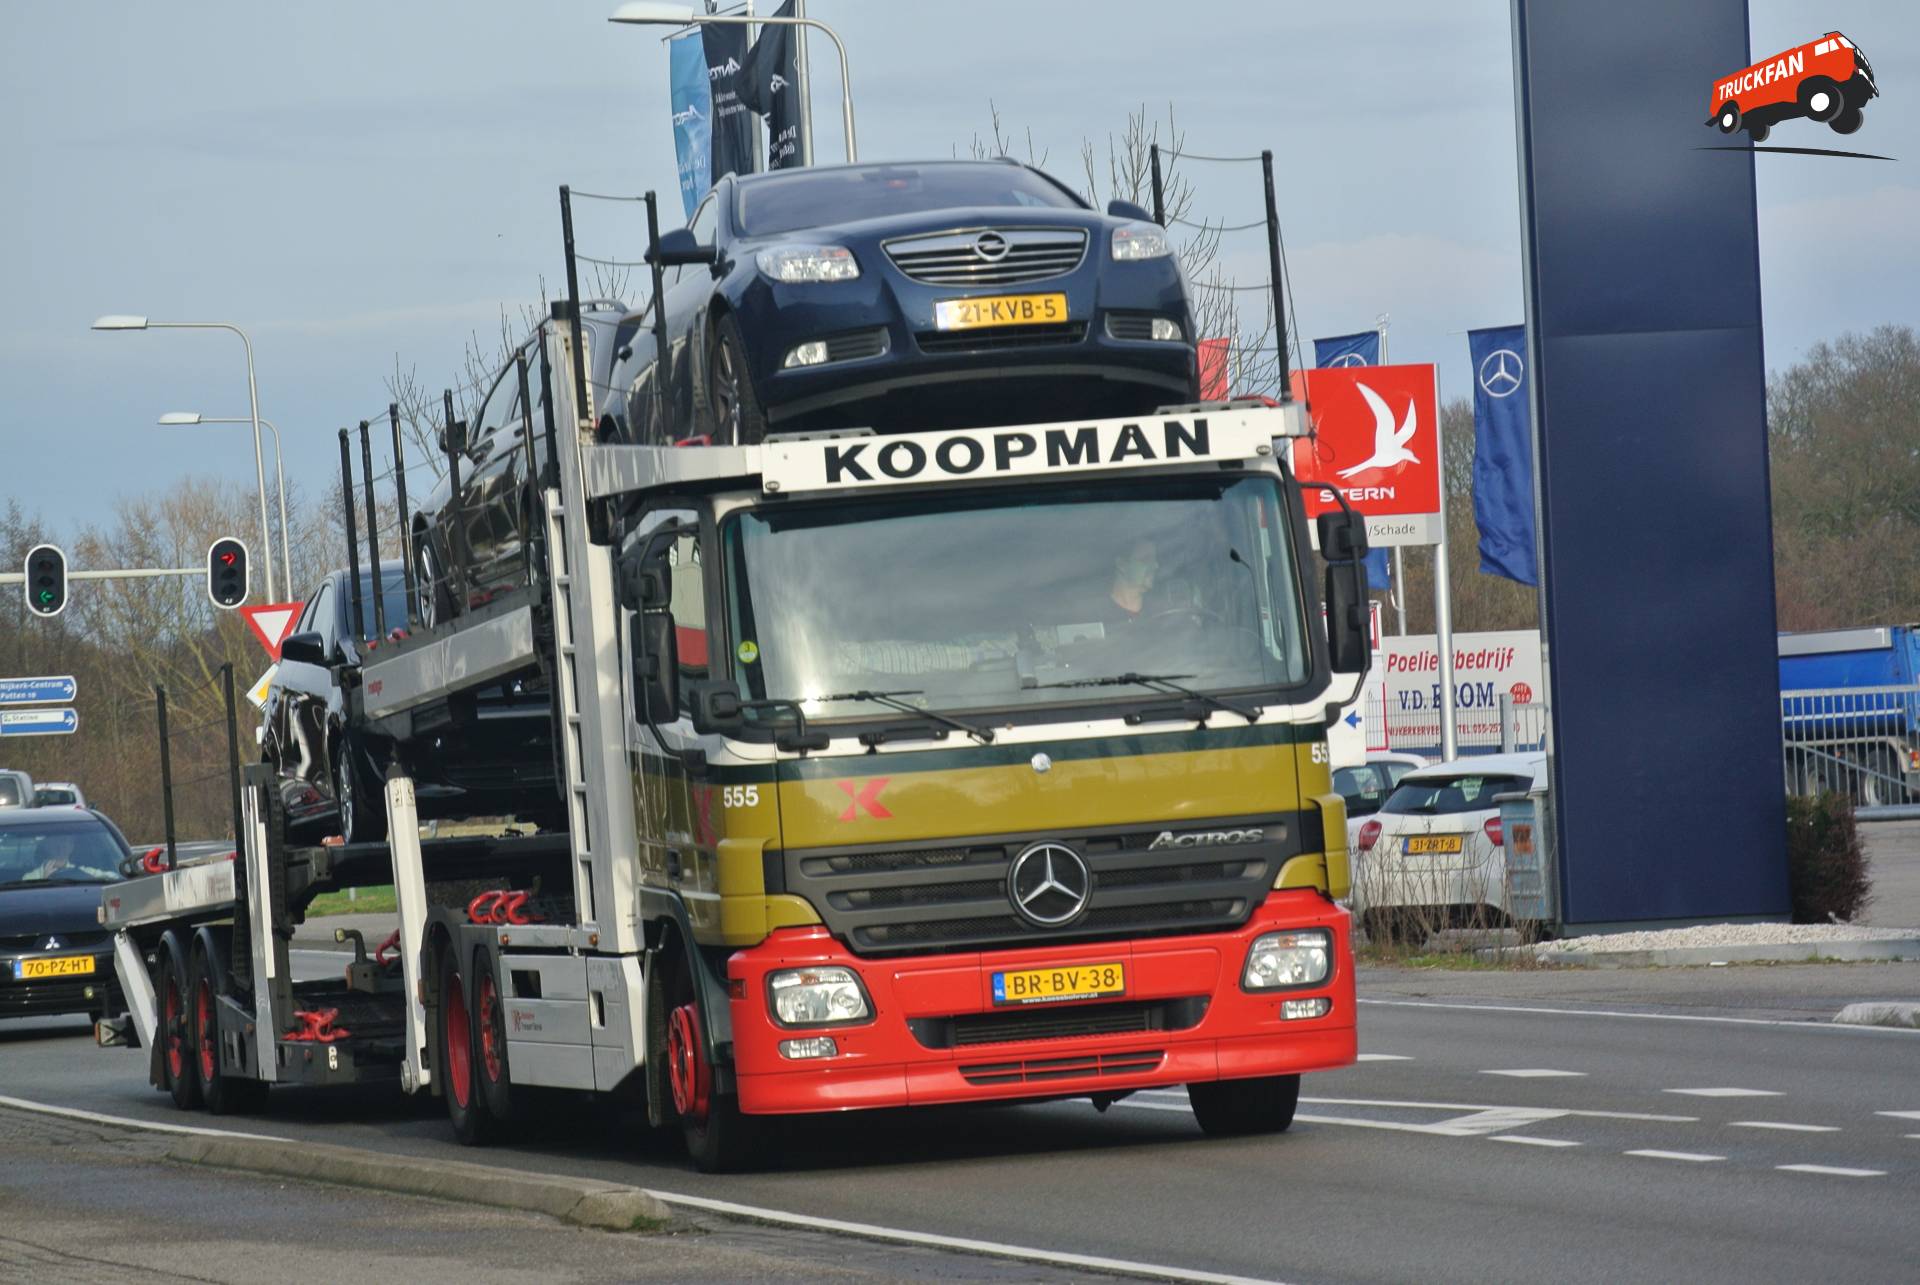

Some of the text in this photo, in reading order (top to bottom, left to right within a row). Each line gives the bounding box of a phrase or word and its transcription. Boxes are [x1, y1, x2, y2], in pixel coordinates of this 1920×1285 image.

[958, 298, 1056, 323] 21-KVB-5
[823, 418, 1210, 483] KOOPMAN
[1319, 486, 1396, 503] STERN
[1387, 647, 1515, 673] Poeliebedrijf
[1399, 690, 1427, 710] V.D.
[724, 785, 759, 808] 555
[1414, 839, 1456, 851] 31-ZRT-8
[26, 958, 89, 976] 70-PZ-HT
[1013, 968, 1116, 995] BR-BV-38
